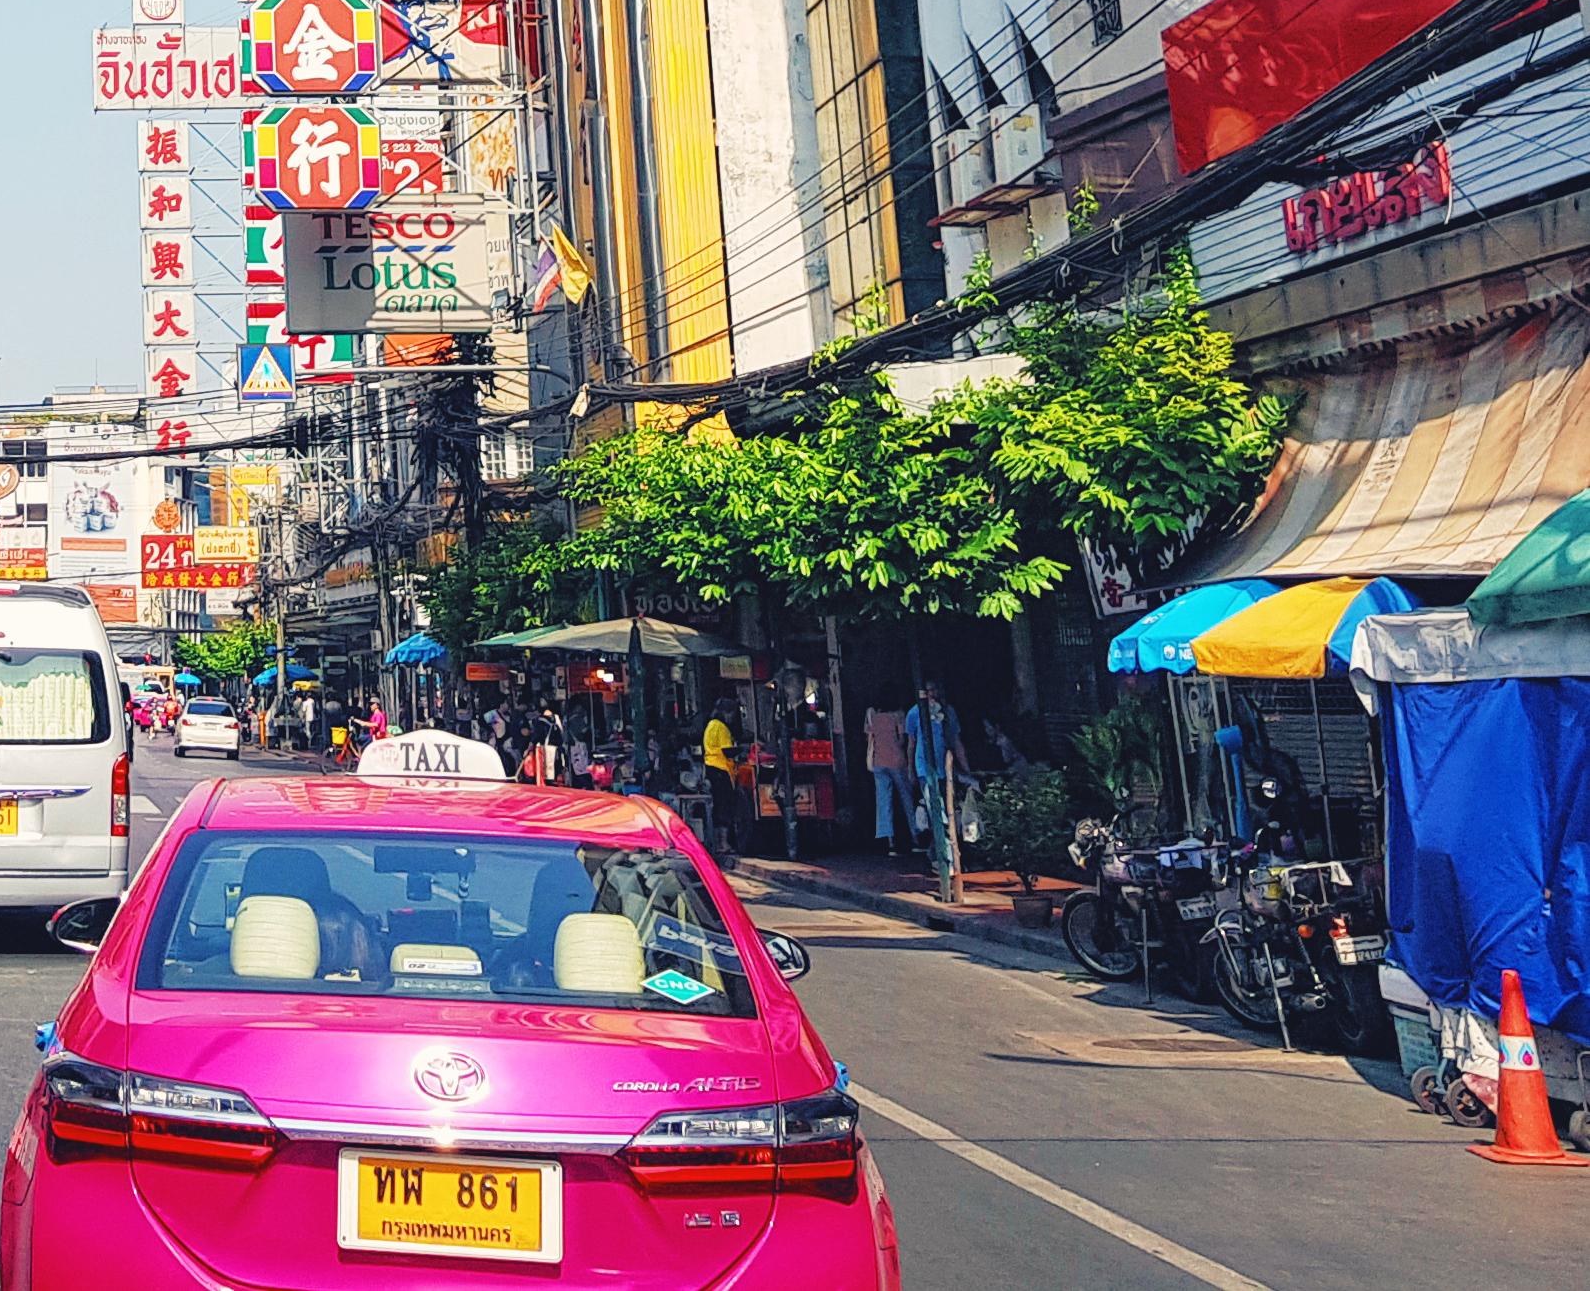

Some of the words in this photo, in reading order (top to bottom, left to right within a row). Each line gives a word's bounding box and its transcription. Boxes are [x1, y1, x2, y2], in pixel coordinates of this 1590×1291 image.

[97, 31, 237, 100] จินฮั้วเฮ
[393, 158, 421, 194] 2
[312, 212, 456, 239] TESCO
[322, 255, 458, 291] Lotus
[144, 126, 194, 460] 振和興大金行
[384, 293, 458, 313] ตลาด
[145, 542, 177, 569] 24
[399, 742, 462, 773] TAXI
[653, 977, 700, 992] CNG
[683, 1076, 762, 1092] ALTIS
[457, 1171, 520, 1213] 861
[380, 1216, 512, 1243] กรุงเทพมหานคร
